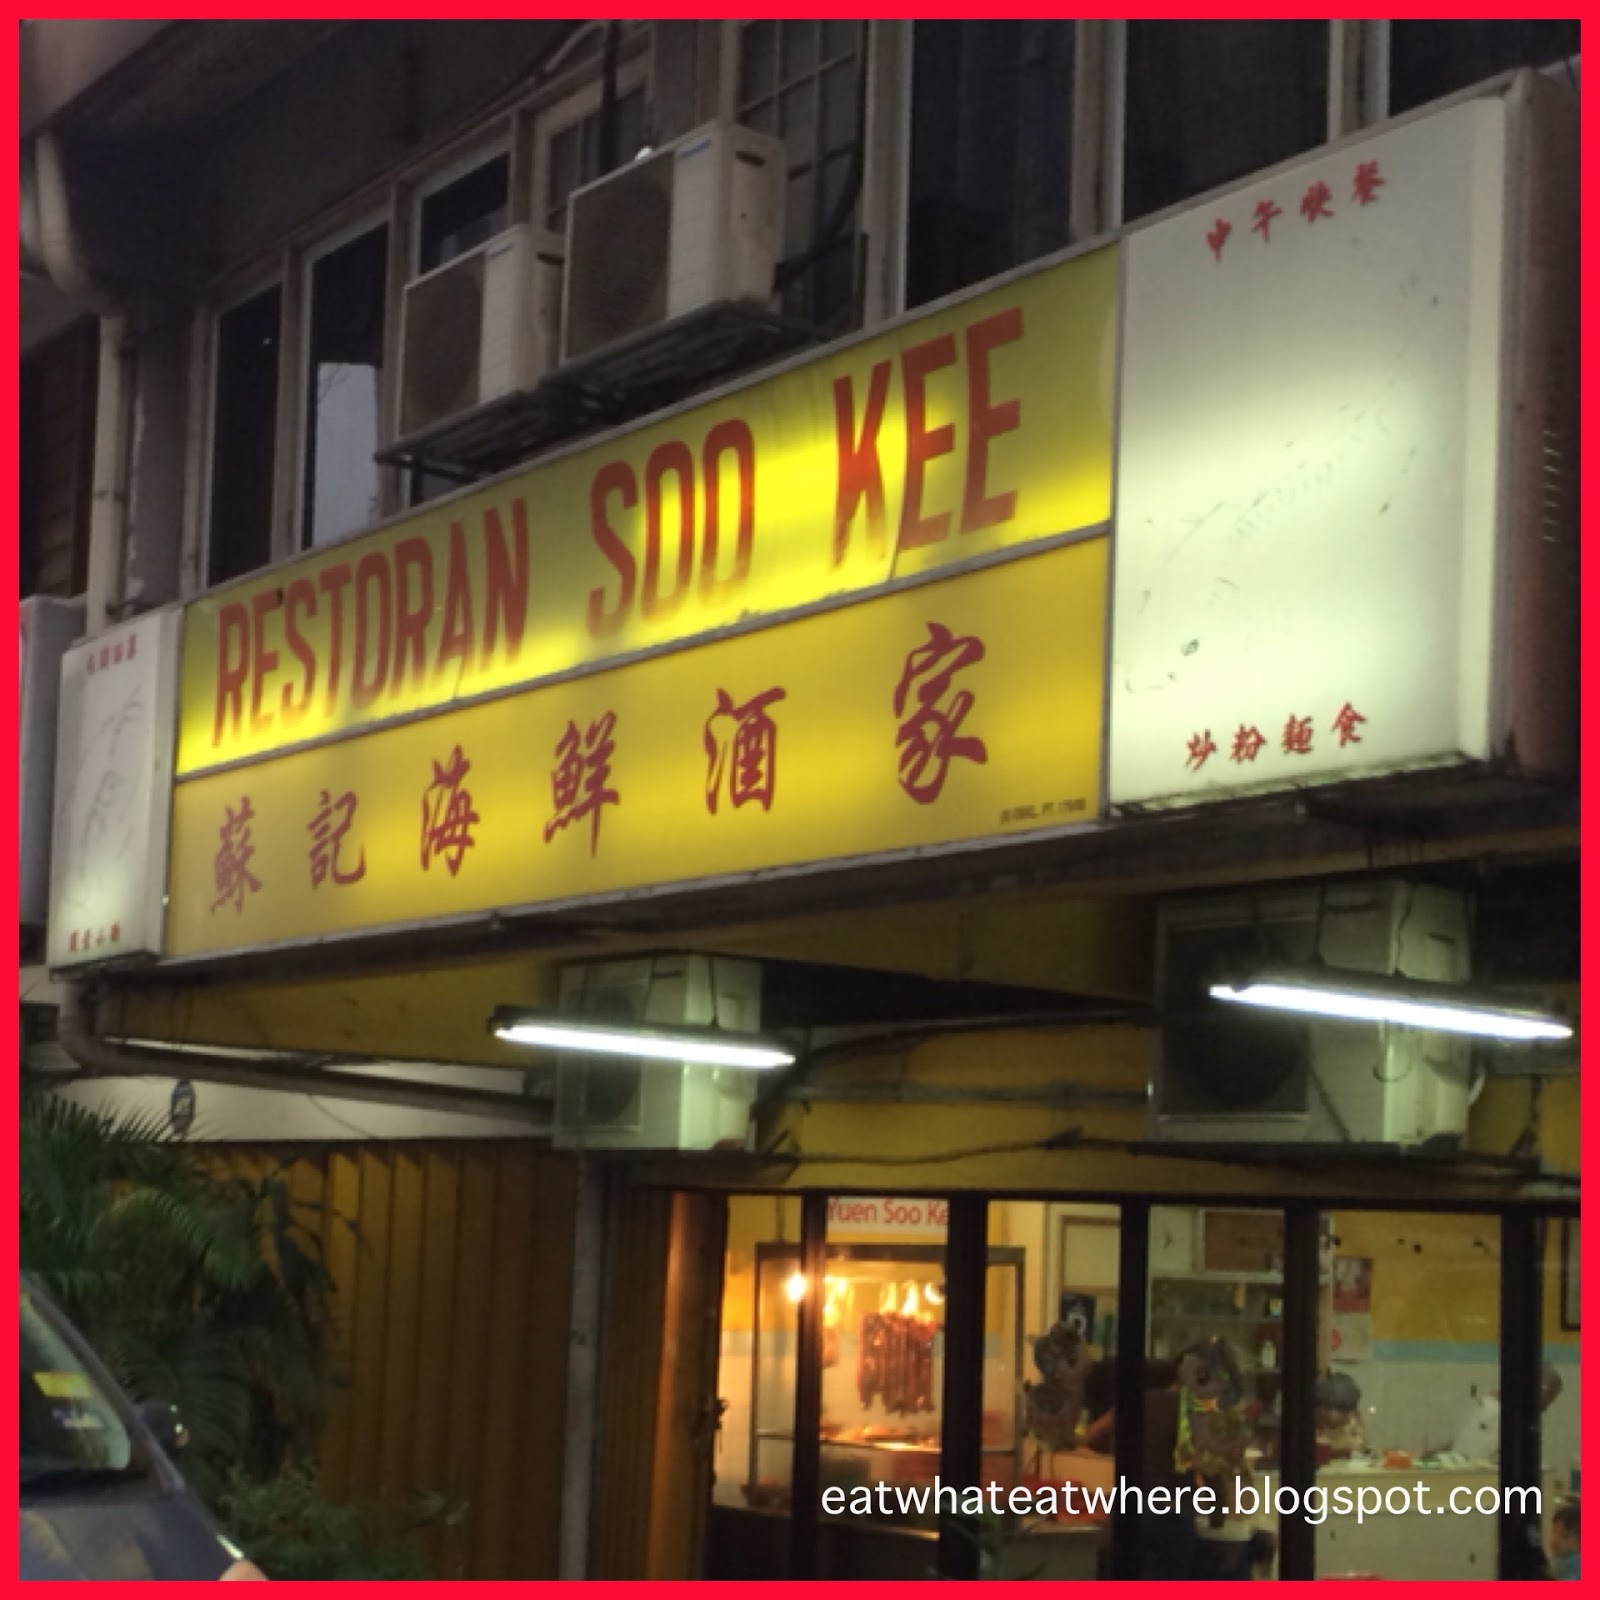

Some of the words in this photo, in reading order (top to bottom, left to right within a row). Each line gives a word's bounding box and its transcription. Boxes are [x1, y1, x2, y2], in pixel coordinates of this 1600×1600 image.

[212, 497, 529, 748] RESTORAN
[586, 417, 756, 641] SOO
[831, 307, 1024, 572] KEE
[209, 621, 989, 915] 蘇記海鮮酒家
[827, 1197, 878, 1223] Yuen
[884, 1196, 921, 1225] Soo
